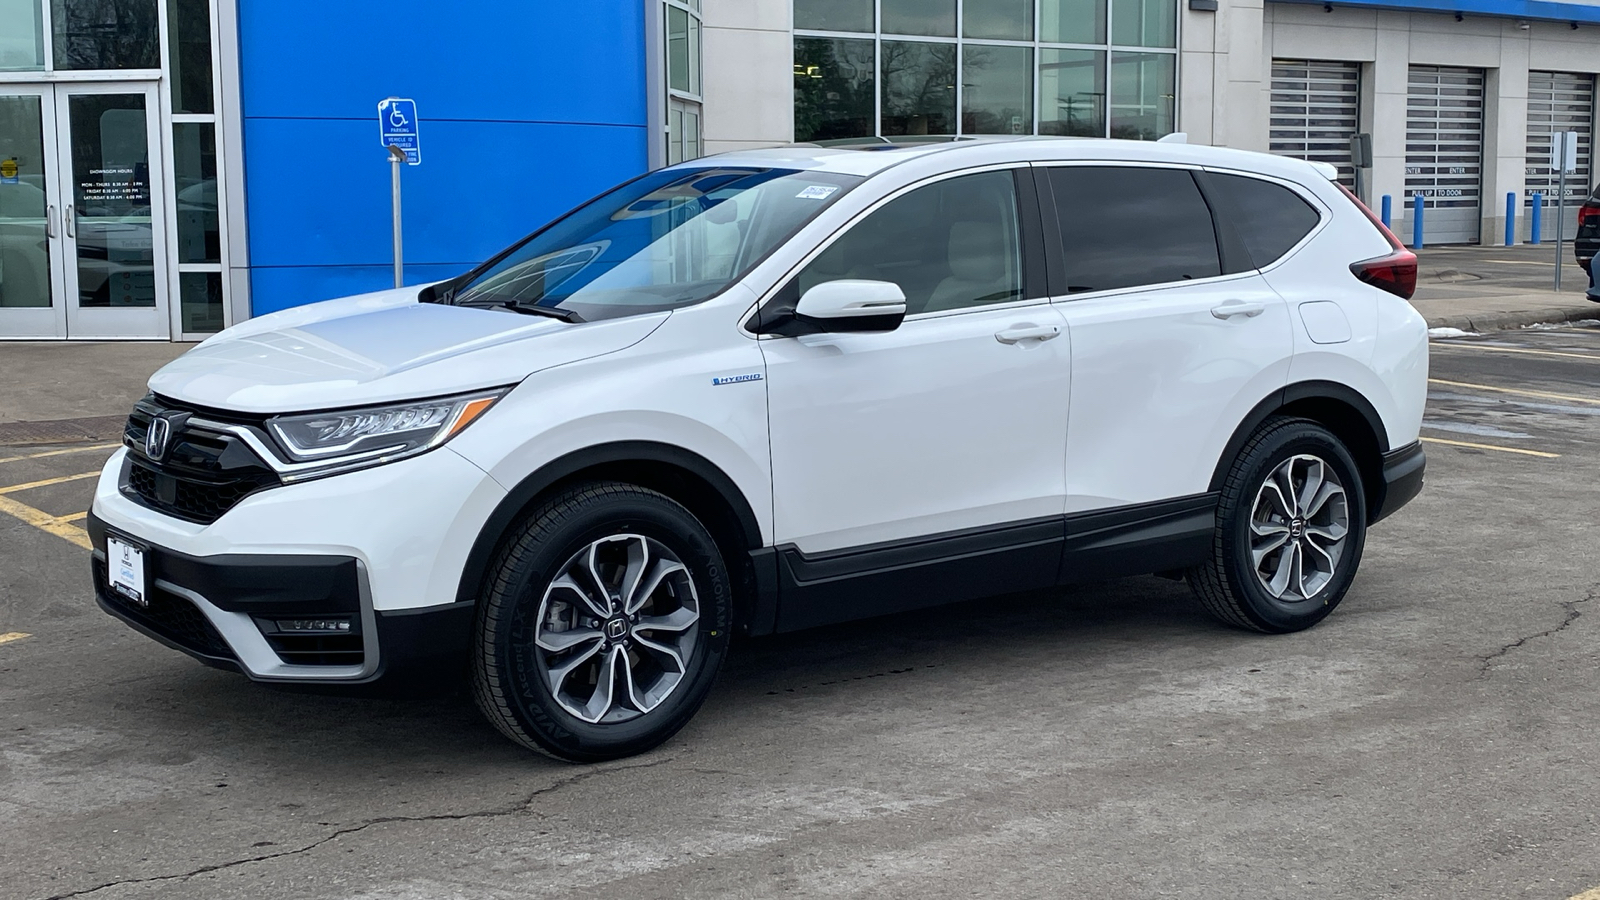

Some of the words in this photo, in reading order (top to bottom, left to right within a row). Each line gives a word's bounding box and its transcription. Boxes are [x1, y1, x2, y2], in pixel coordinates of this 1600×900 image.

[720, 374, 760, 383] HYBRID
[706, 558, 726, 638] YOKOHAMA
[514, 644, 534, 699] Ascend
[528, 702, 570, 740] AVID
